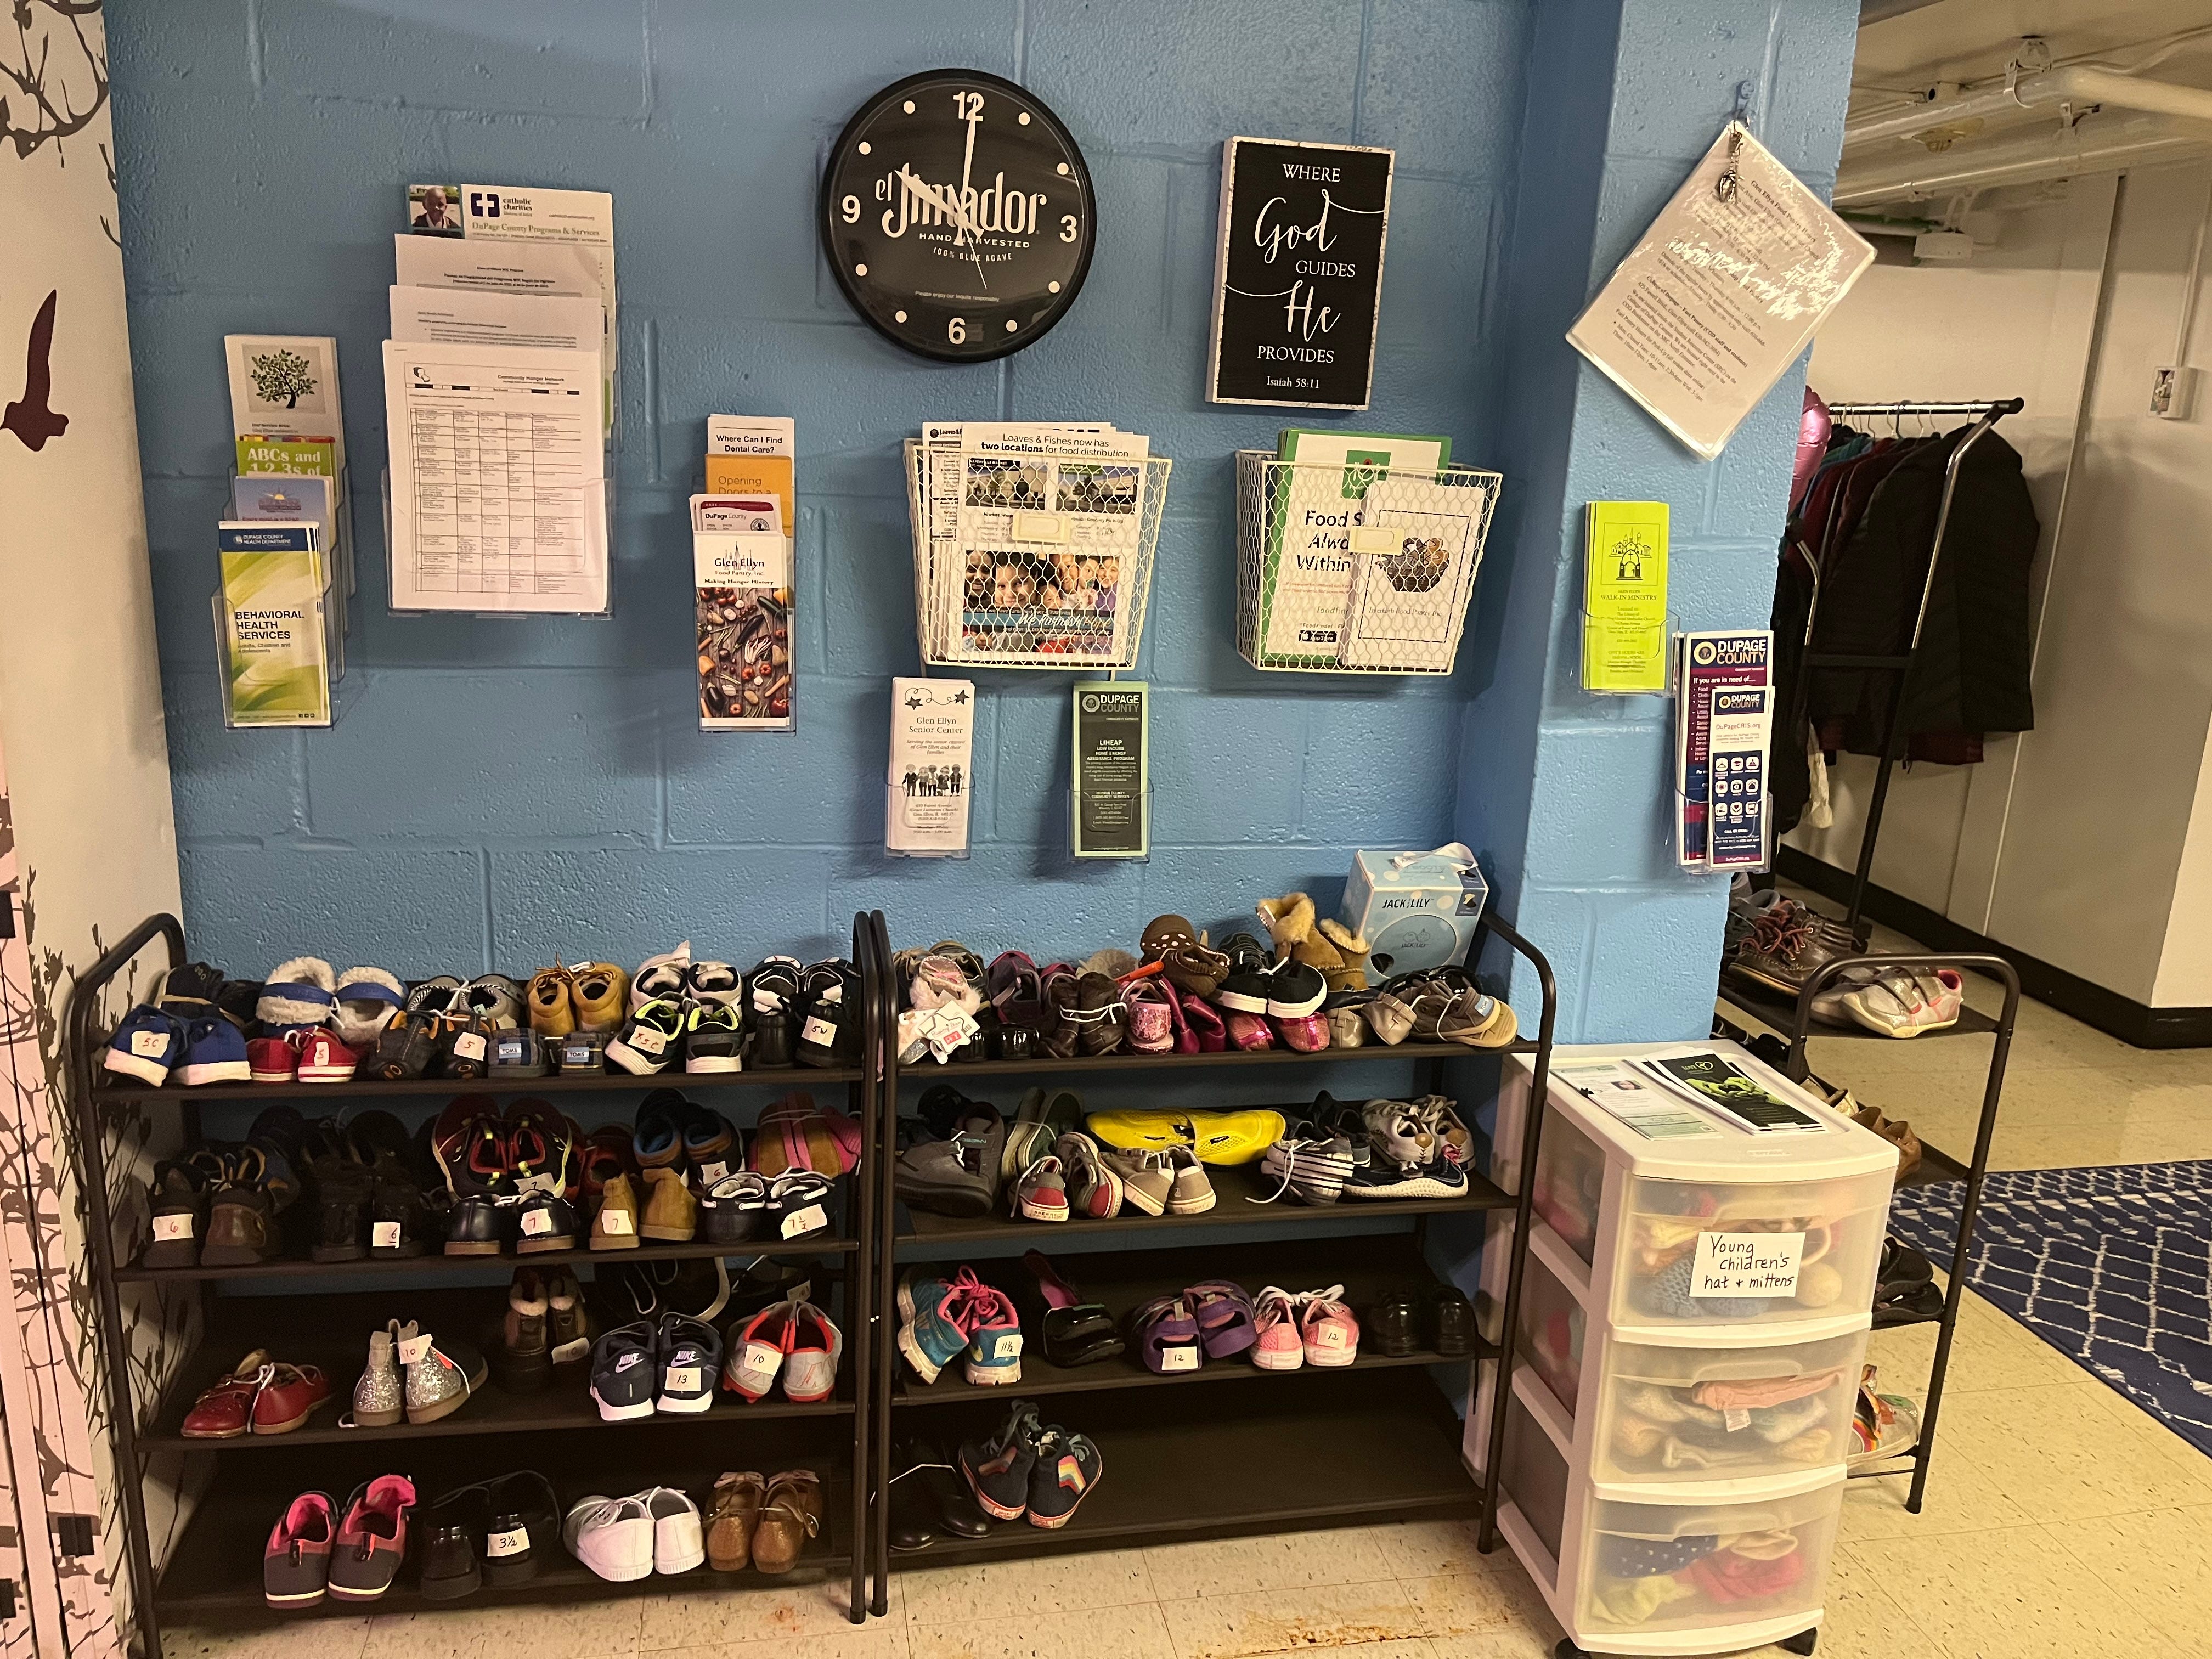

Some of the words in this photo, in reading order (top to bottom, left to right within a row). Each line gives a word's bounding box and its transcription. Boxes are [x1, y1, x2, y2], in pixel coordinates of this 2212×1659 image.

[952, 91, 984, 121] 12
[1283, 163, 1341, 182] WHERE
[842, 195, 861, 223] 9
[472, 222, 500, 231] DuPage
[501, 223, 527, 233] County
[529, 225, 561, 235] Programs
[572, 228, 600, 236] Services
[1060, 215, 1077, 242] 3
[1255, 189, 1348, 264] God
[933, 247, 955, 258] 100%
[960, 253, 980, 262] BLUE
[985, 253, 1012, 262] AGAVE
[1296, 259, 1356, 278] GUIDES
[1276, 280, 1341, 342] He
[948, 317, 966, 345] 6
[1257, 345, 1334, 363] PROVIDES
[1267, 376, 1293, 388] Isaiah
[1295, 377, 1319, 389] 58:11
[1002, 433, 1034, 443] Loaves
[1045, 436, 1071, 445] Fishes
[1095, 439, 1109, 448] has
[248, 448, 289, 462] ABCs
[295, 452, 320, 462] and
[1001, 443, 1043, 453] locations
[1045, 445, 1058, 454] for
[1059, 445, 1080, 455] food
[1081, 447, 1128, 457] distribution
[718, 476, 761, 487] Opening
[1305, 510, 1348, 527] Food
[714, 558, 737, 566] Glen
[740, 558, 764, 571] Ellyn
[235, 611, 304, 619] BEHAVIORAL
[237, 621, 278, 629] HEALTH
[239, 631, 291, 639] SERVICES
[1718, 639, 1767, 653] DUPAGE
[1717, 652, 1766, 664] COUNTY
[1101, 695, 1139, 703] DUPAGE
[1101, 704, 1139, 712] COUNTY
[938, 718, 956, 726] Ellyn
[1383, 899, 1406, 908] JACK
[1410, 899, 1430, 907] LILY
[143, 1037, 159, 1048] 5C
[317, 1049, 324, 1060] 5
[170, 1221, 178, 1233] 6
[529, 1217, 537, 1229] 7
[612, 1218, 618, 1230] 7
[391, 1227, 398, 1239] 6
[1711, 1235, 1754, 1259] Young
[1720, 1252, 1790, 1270] children's
[1705, 1274, 1729, 1289] hat
[1749, 1273, 1795, 1288] mittens
[1328, 1332, 1339, 1341] 12
[405, 1348, 416, 1357] 10
[619, 1352, 640, 1365] NIKE
[675, 1350, 696, 1361] NIKE
[753, 1353, 764, 1363] 10
[1174, 1353, 1184, 1362] 12
[676, 1375, 687, 1384] 13
